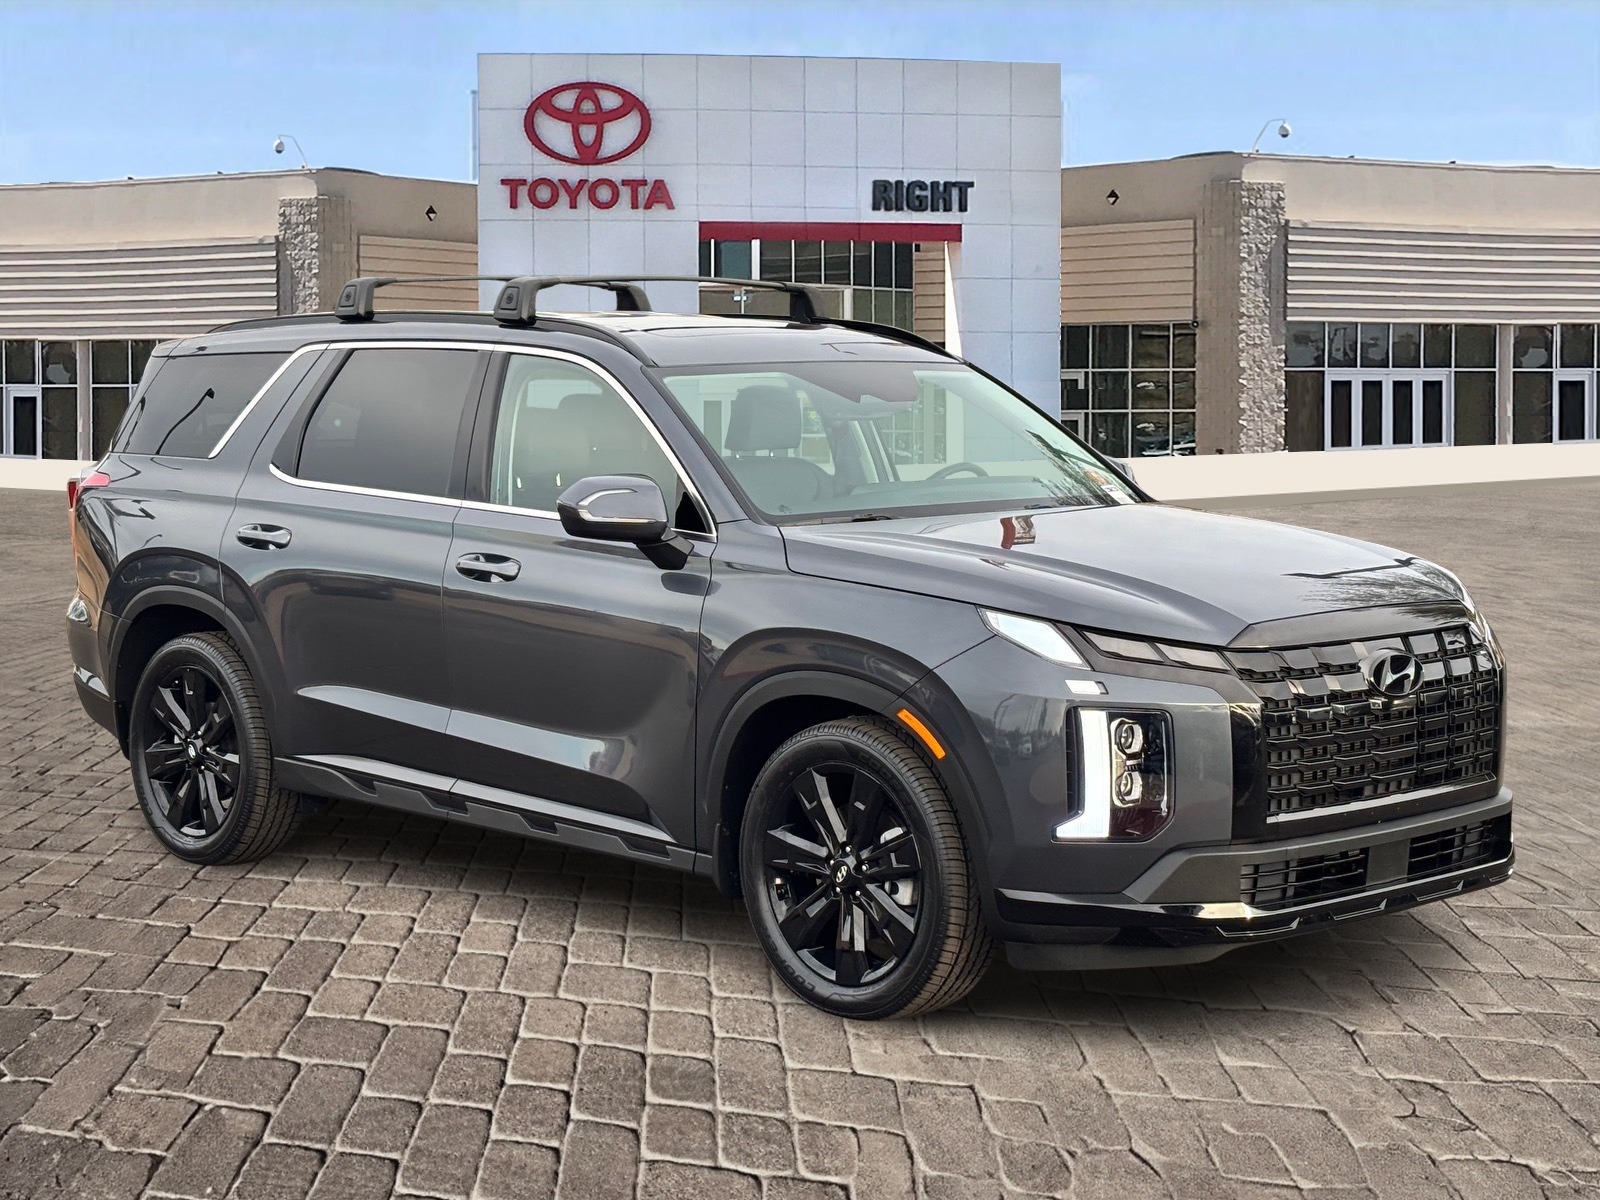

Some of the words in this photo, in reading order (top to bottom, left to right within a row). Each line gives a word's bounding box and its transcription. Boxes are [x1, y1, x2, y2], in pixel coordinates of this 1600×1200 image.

[500, 177, 675, 209] TOYOTA
[872, 180, 975, 212] RIGHT
[761, 924, 815, 994] COOPER
